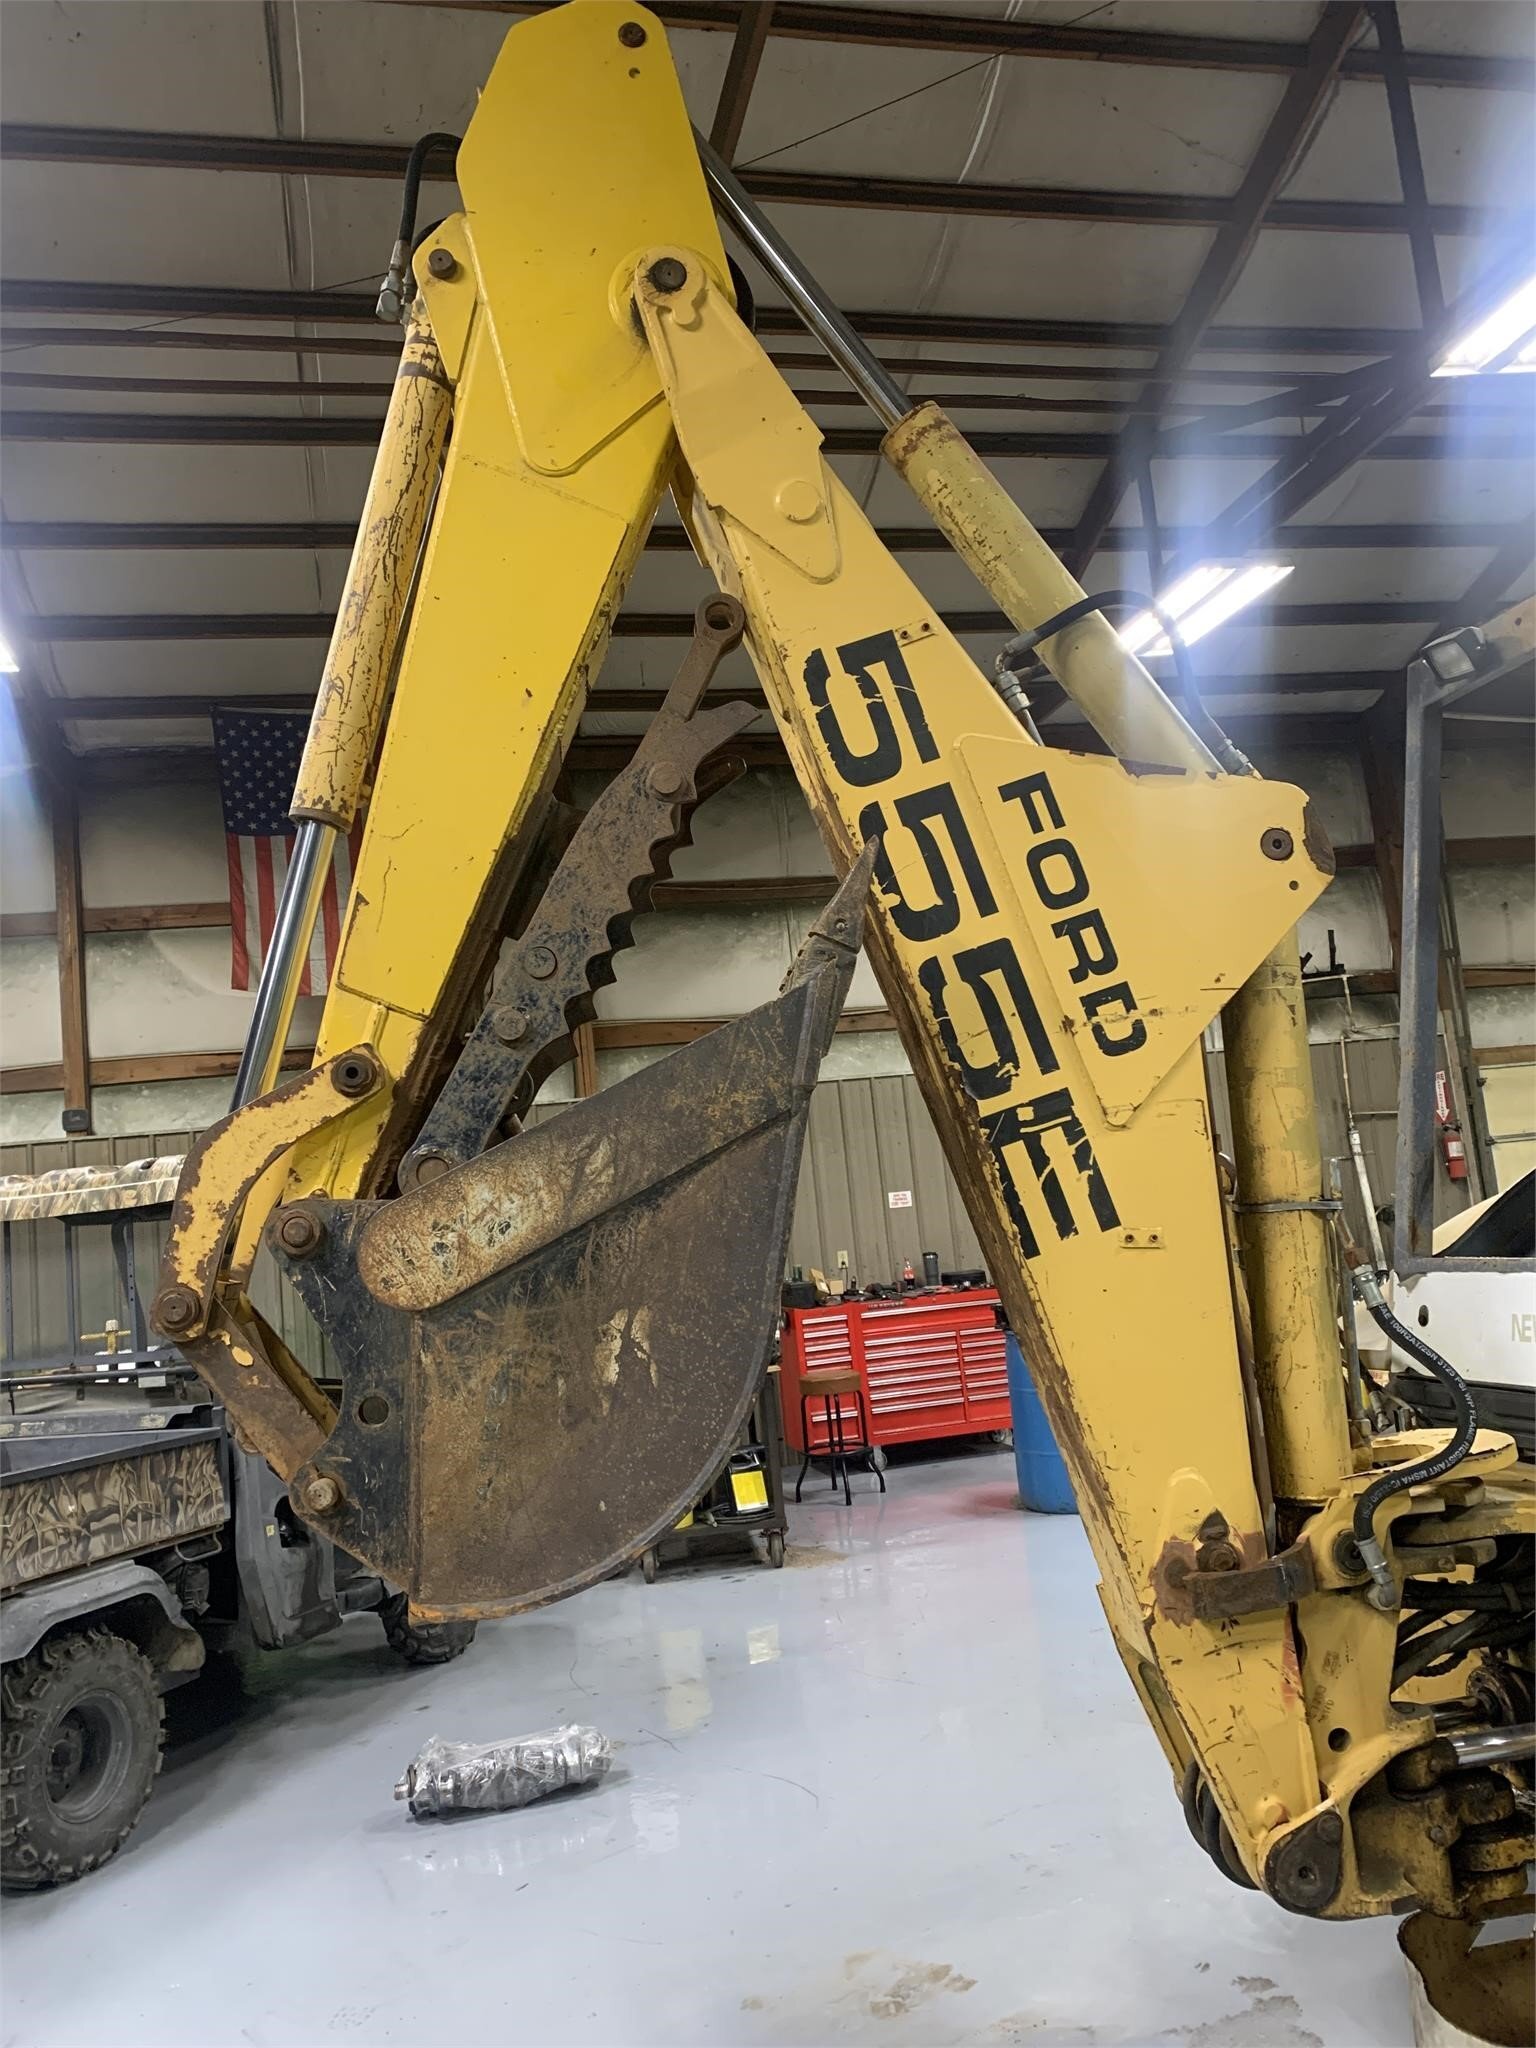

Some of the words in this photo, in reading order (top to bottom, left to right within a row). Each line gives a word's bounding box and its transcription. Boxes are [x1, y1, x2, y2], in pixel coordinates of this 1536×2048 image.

[998, 771, 1148, 1057] FORD
[803, 630, 1122, 1260] 555E
[1511, 1313, 1536, 1343] NE
[1428, 1441, 1470, 1475] RESISTANT
[1401, 1471, 1429, 1485] MSHA
